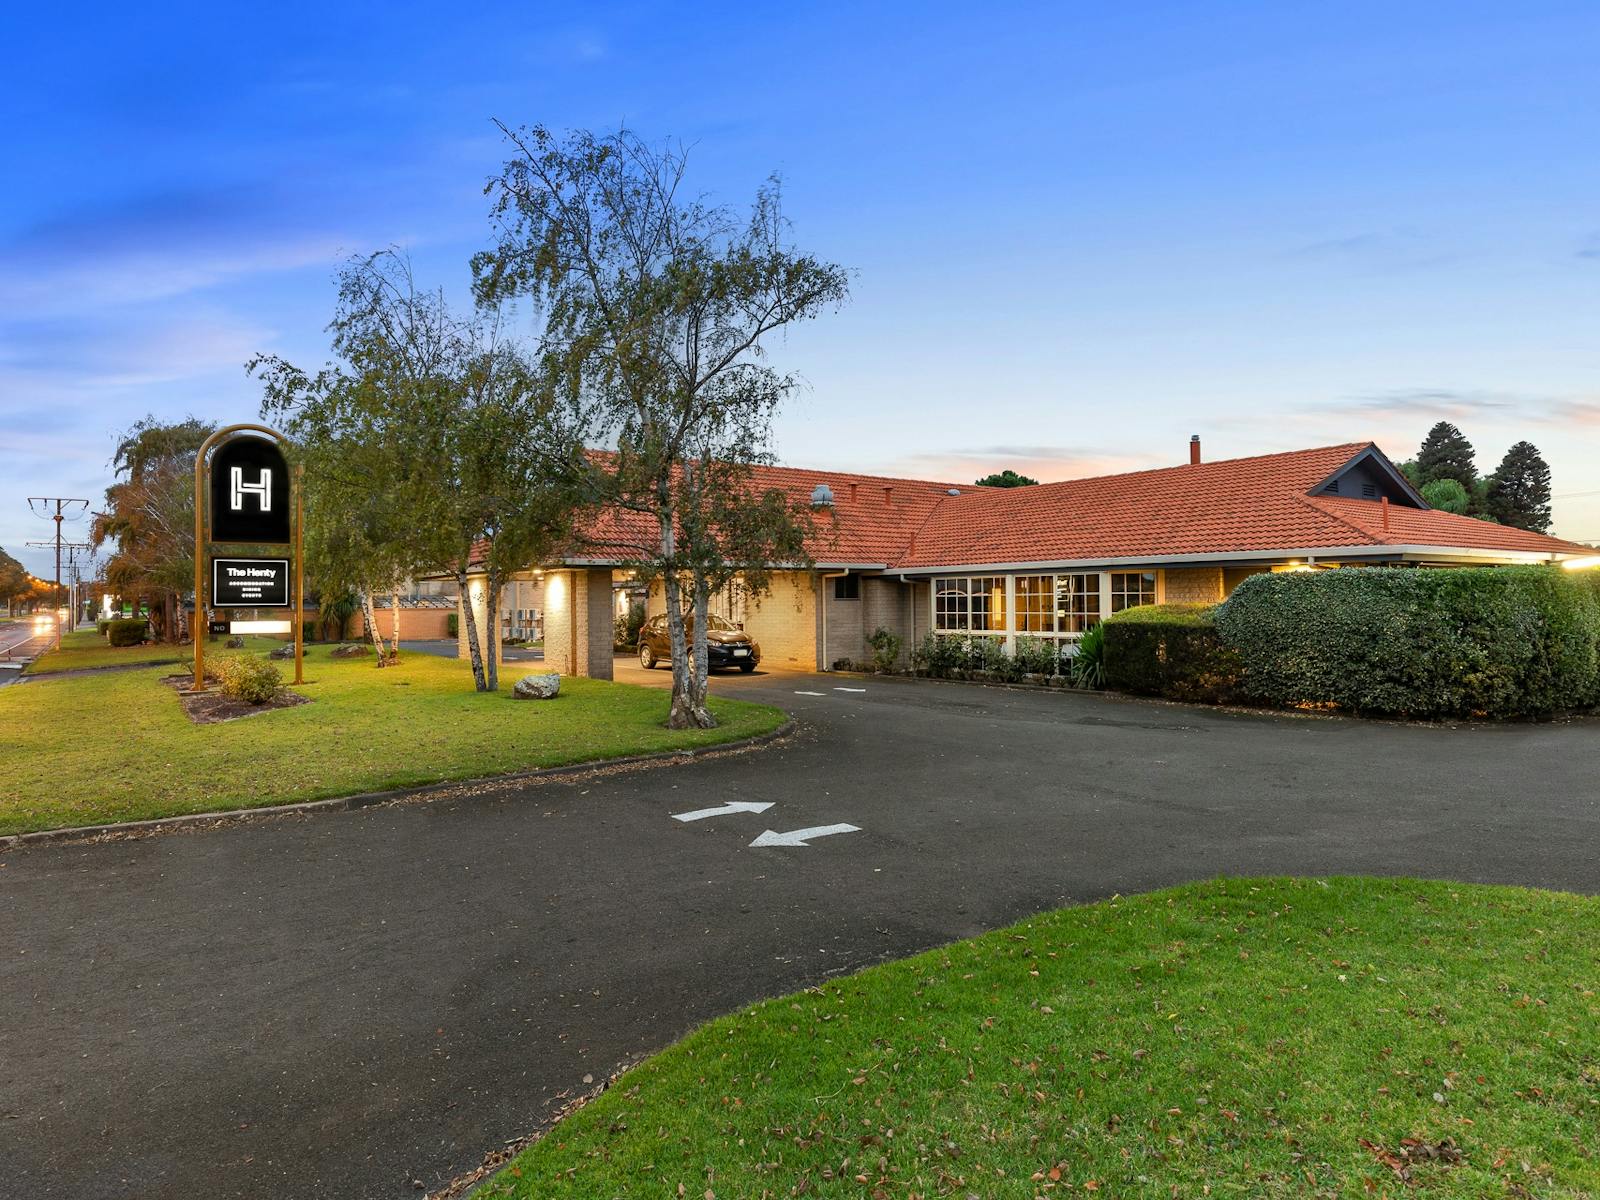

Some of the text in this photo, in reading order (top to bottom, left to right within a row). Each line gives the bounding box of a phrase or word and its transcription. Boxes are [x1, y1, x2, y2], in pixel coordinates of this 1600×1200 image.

[231, 467, 272, 512] H
[226, 567, 276, 578] The Henty
